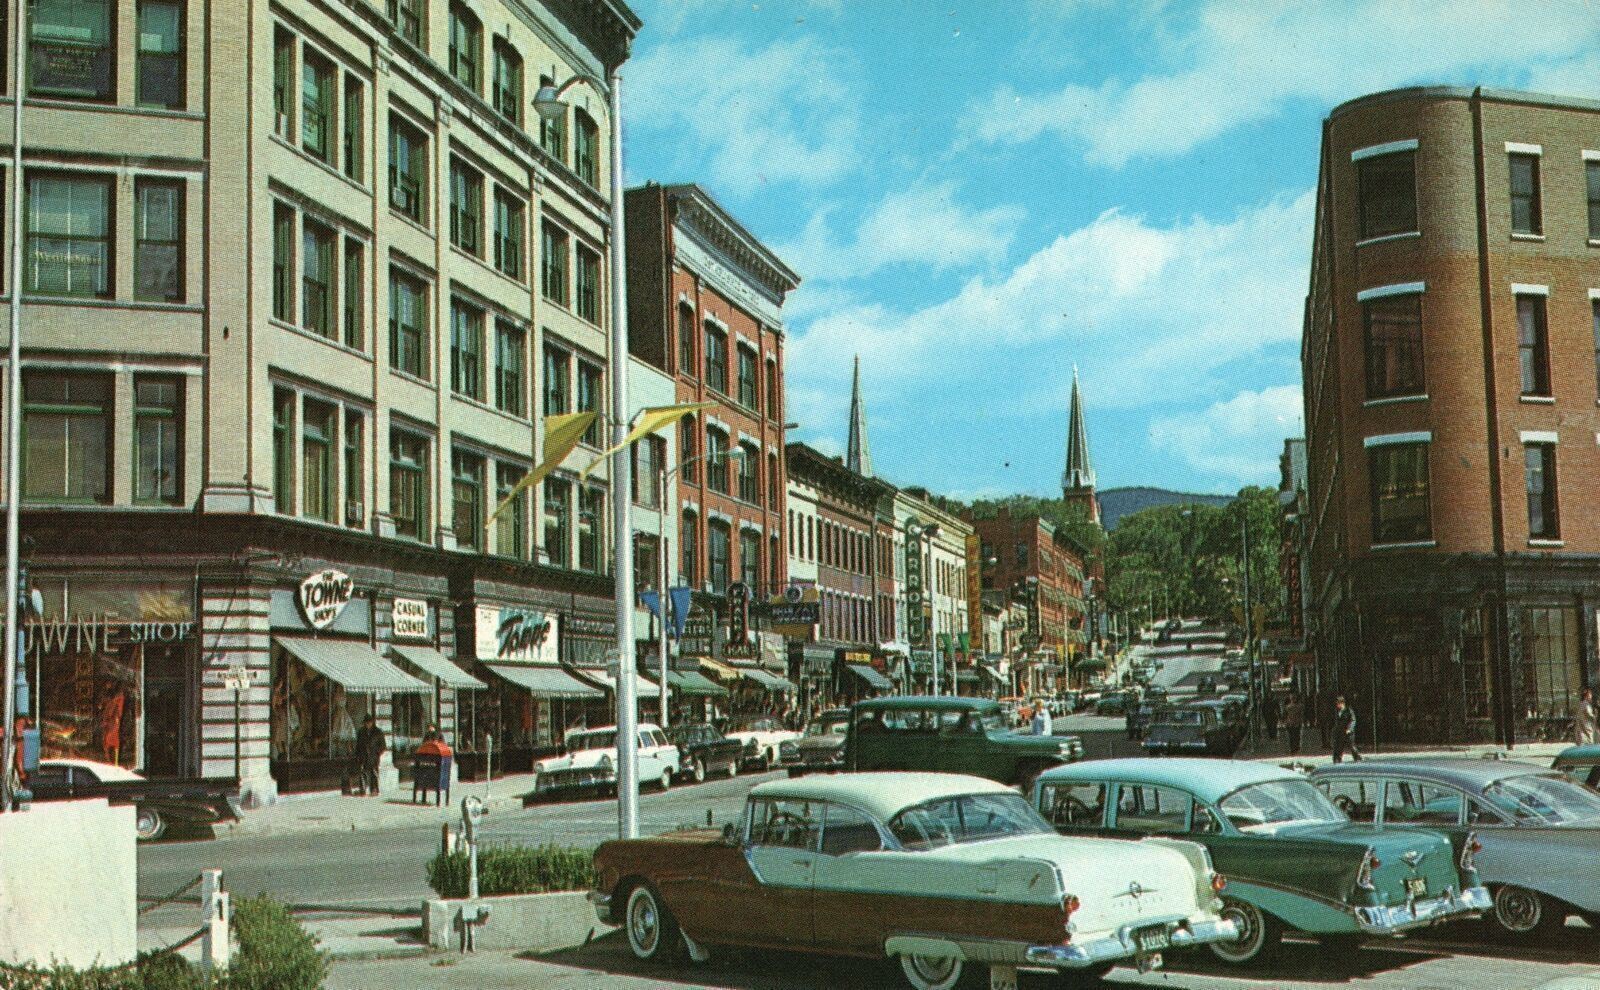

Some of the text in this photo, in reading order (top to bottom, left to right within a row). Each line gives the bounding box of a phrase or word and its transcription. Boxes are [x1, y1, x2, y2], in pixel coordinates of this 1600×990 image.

[906, 524, 922, 639] CARROLL
[304, 577, 352, 609] TOWNE
[396, 602, 426, 618] CASUAL
[129, 621, 192, 642] SHOP
[396, 618, 426, 634] CORNER
